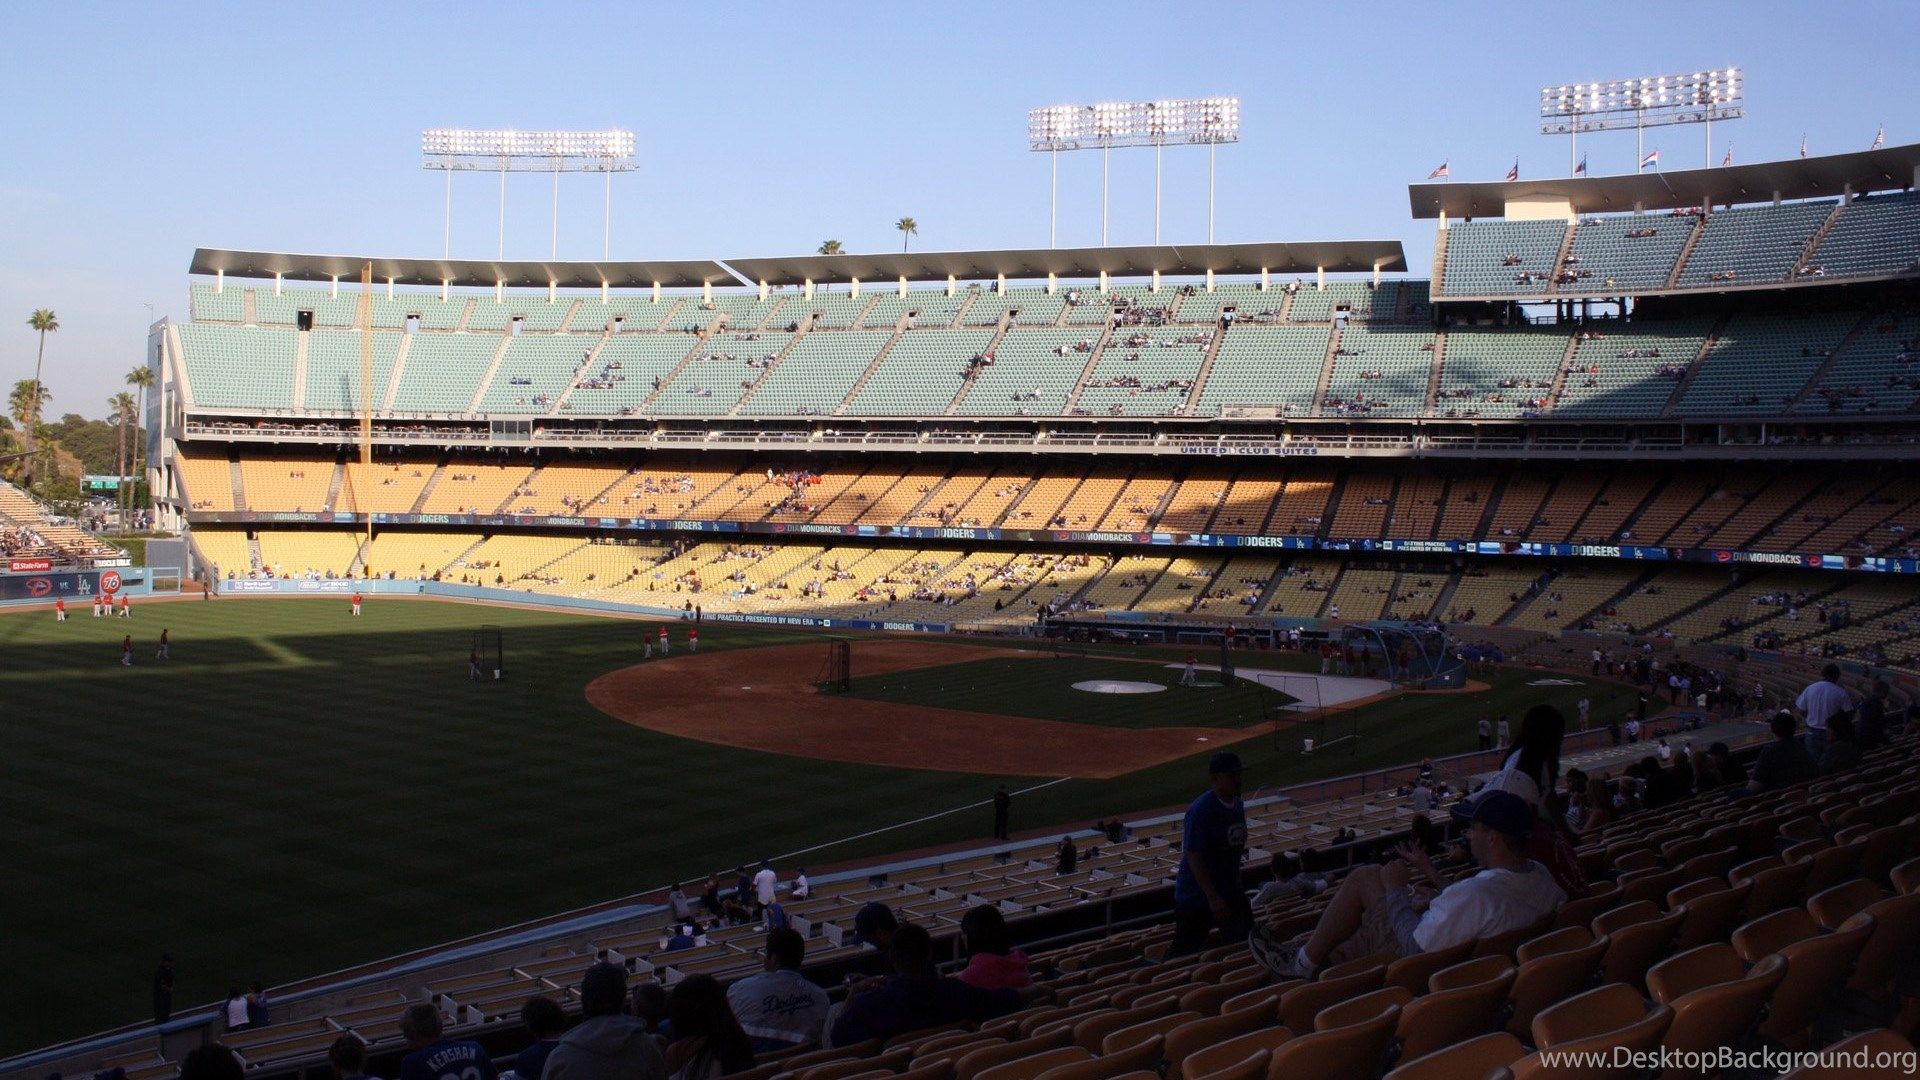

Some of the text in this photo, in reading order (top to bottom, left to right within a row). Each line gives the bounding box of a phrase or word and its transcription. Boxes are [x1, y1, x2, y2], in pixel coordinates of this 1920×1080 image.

[1275, 447, 1318, 455] SUITES
[410, 514, 449, 523] DODGERS
[666, 520, 703, 530] DODGERS
[934, 528, 976, 538] DODGERS
[1237, 536, 1283, 547] DODGERS
[1570, 545, 1620, 557] DODGERS
[103, 575, 119, 591] 76
[718, 613, 745, 622] PRACTICE
[745, 615, 778, 624] PRESENTED
[883, 621, 915, 631] DODGERS
[762, 994, 816, 1015] Dodgers
[425, 1045, 477, 1073] KERSHAW
